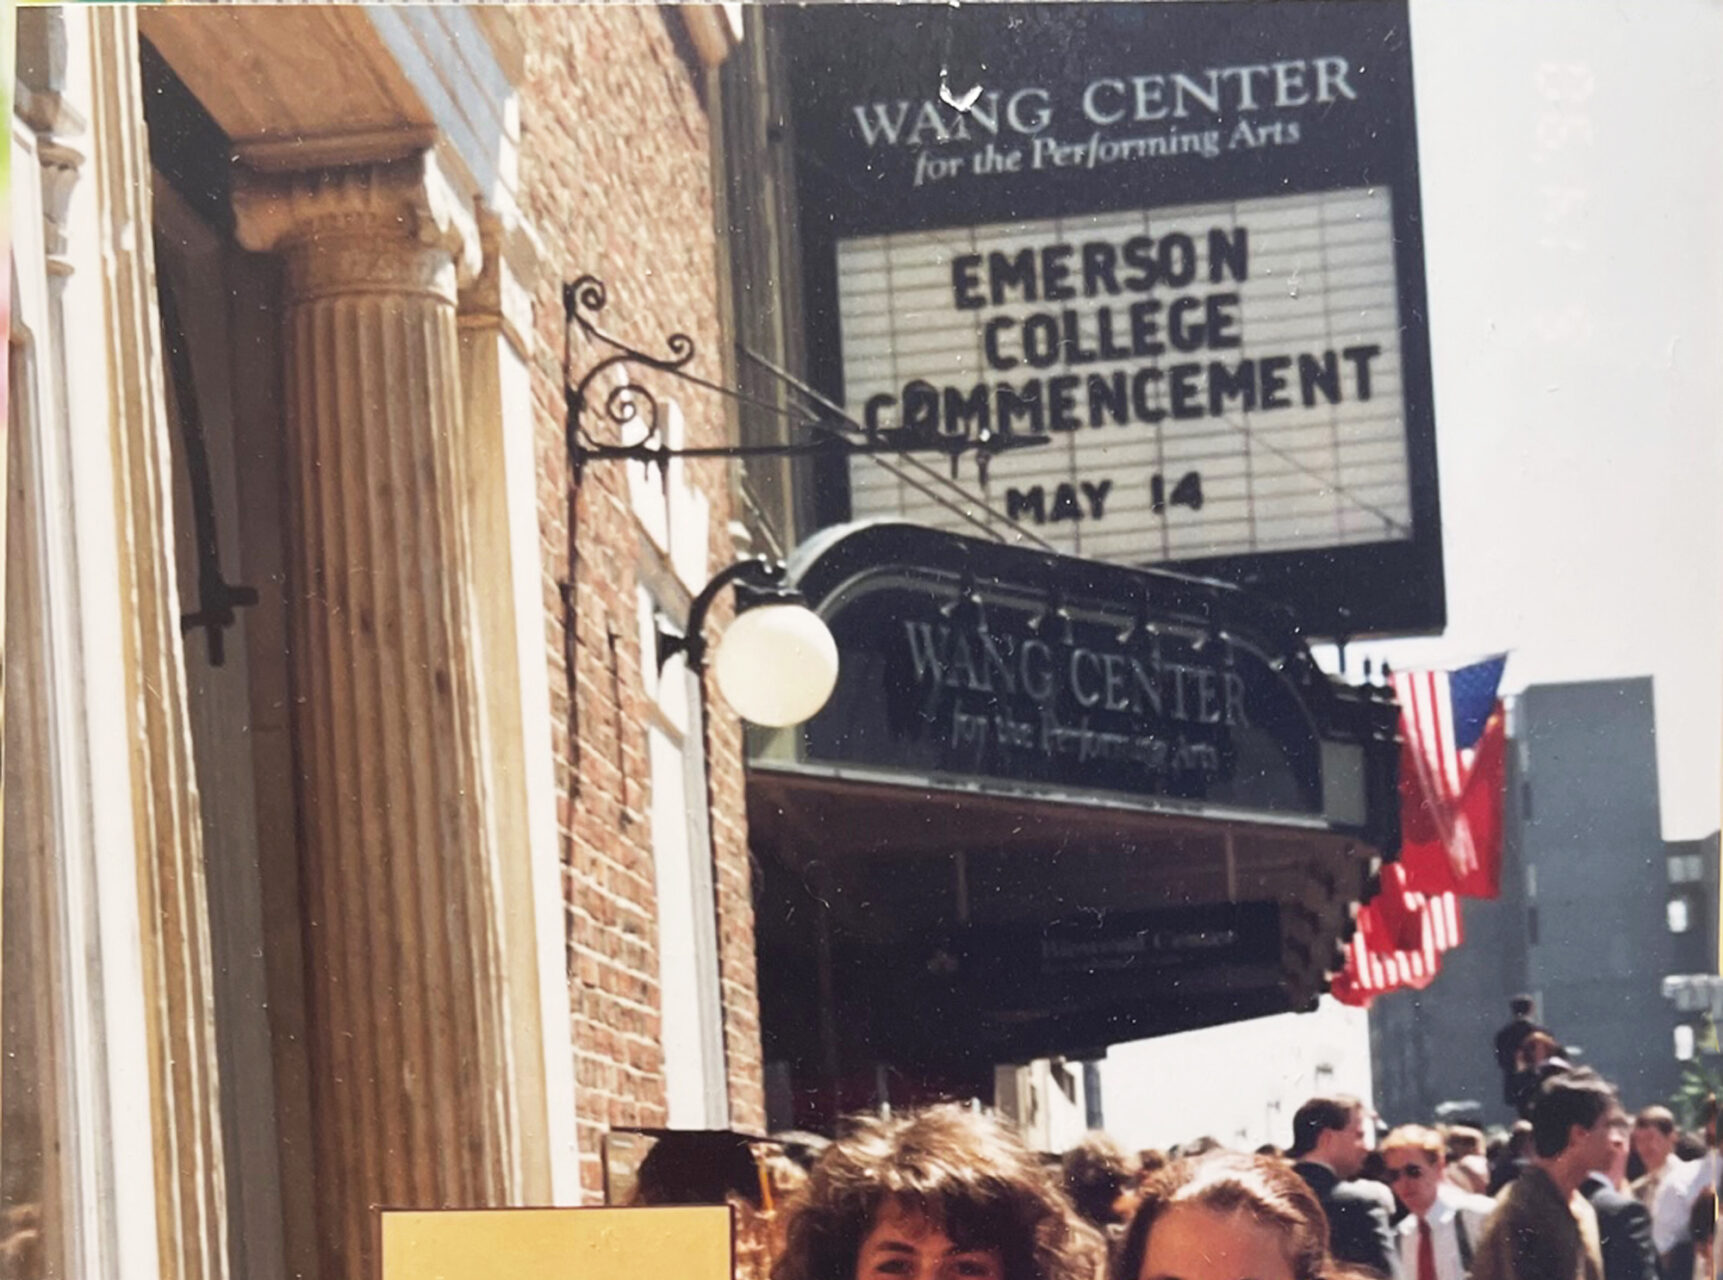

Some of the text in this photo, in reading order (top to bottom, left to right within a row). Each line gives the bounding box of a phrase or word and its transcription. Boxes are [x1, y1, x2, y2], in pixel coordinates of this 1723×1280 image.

[853, 55, 1358, 147] WANG CENTER
[913, 118, 1301, 187] for the Performing Arts
[951, 228, 1249, 311] EMERSON
[984, 293, 1241, 371] COLLEGE
[864, 345, 1381, 448] COMMENCEMENT
[1004, 471, 1205, 525] MAY 14
[904, 620, 1249, 729] WANG CENTER
